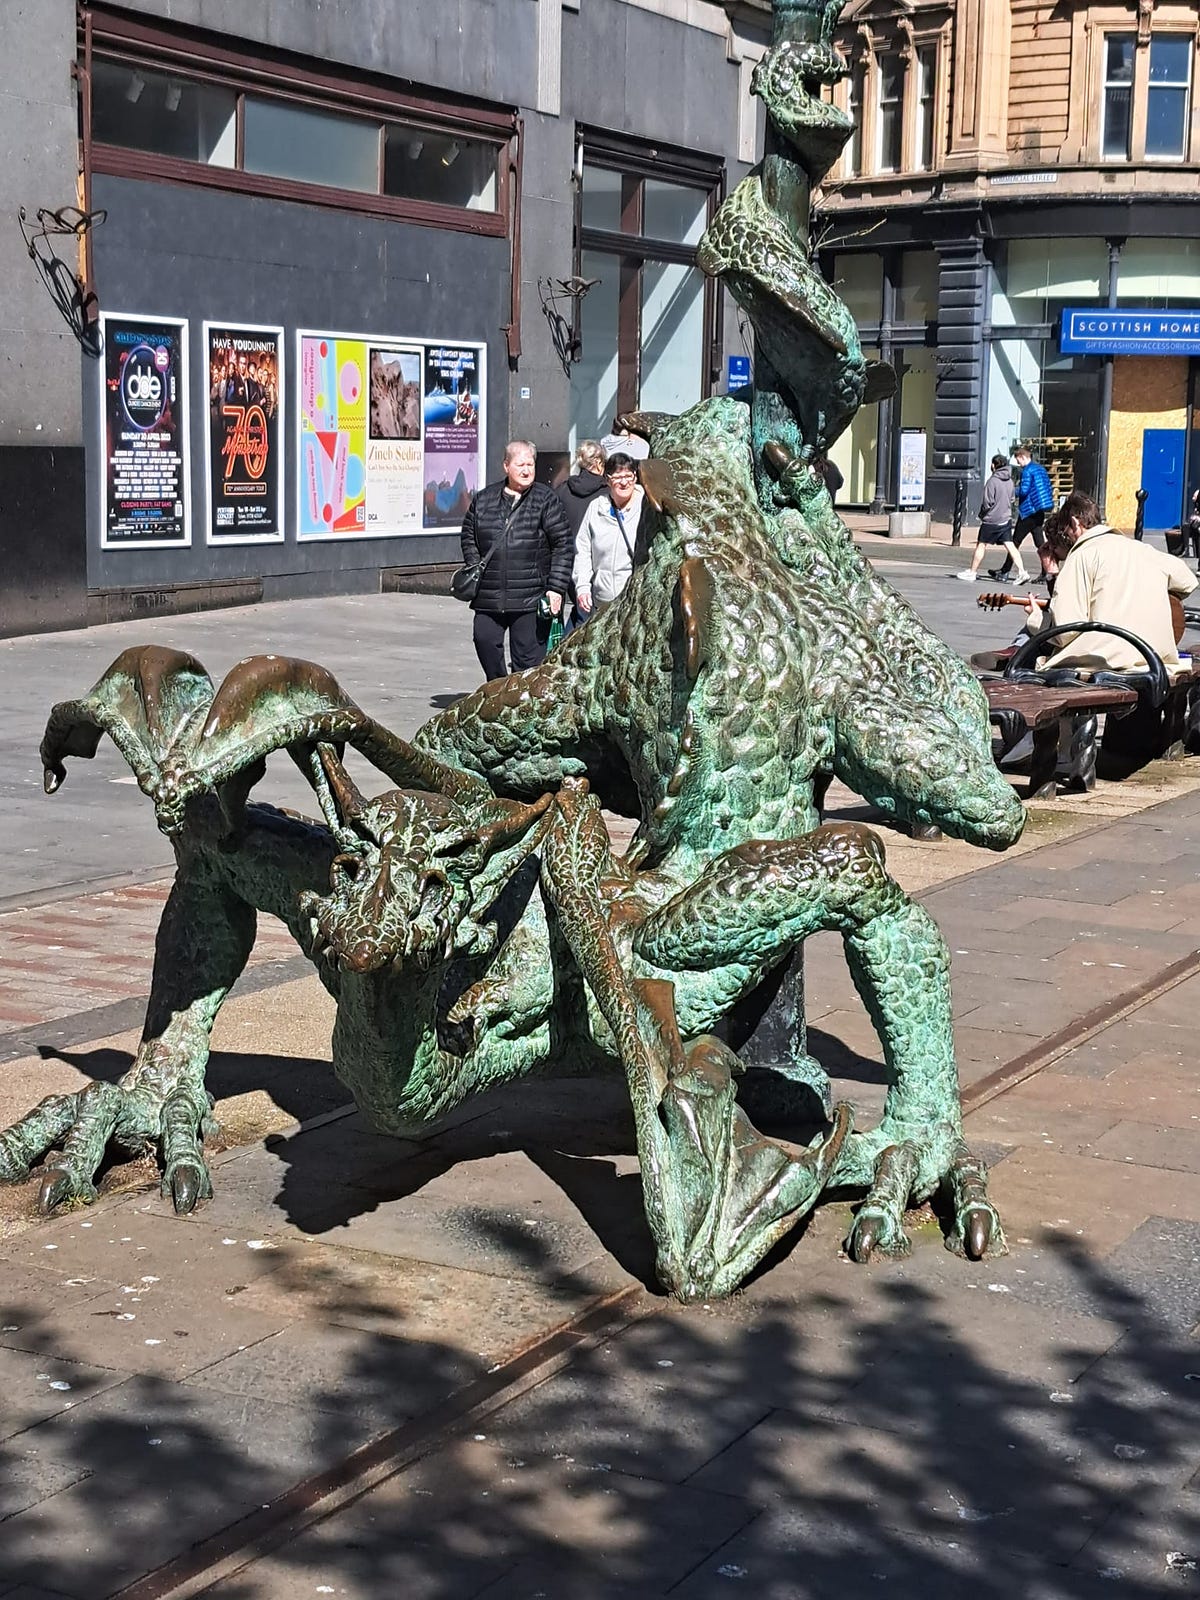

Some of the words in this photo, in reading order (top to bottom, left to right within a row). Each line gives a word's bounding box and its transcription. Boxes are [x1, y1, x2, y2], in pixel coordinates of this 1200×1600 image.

[1032, 173, 1054, 182] STREET
[1079, 321, 1151, 332] SCOTTISH
[1160, 323, 1199, 333] HOME
[212, 337, 231, 349] HAVE
[232, 338, 275, 353] YOUDUNNIT?
[223, 405, 268, 478] 70
[395, 446, 422, 460] Sedira
